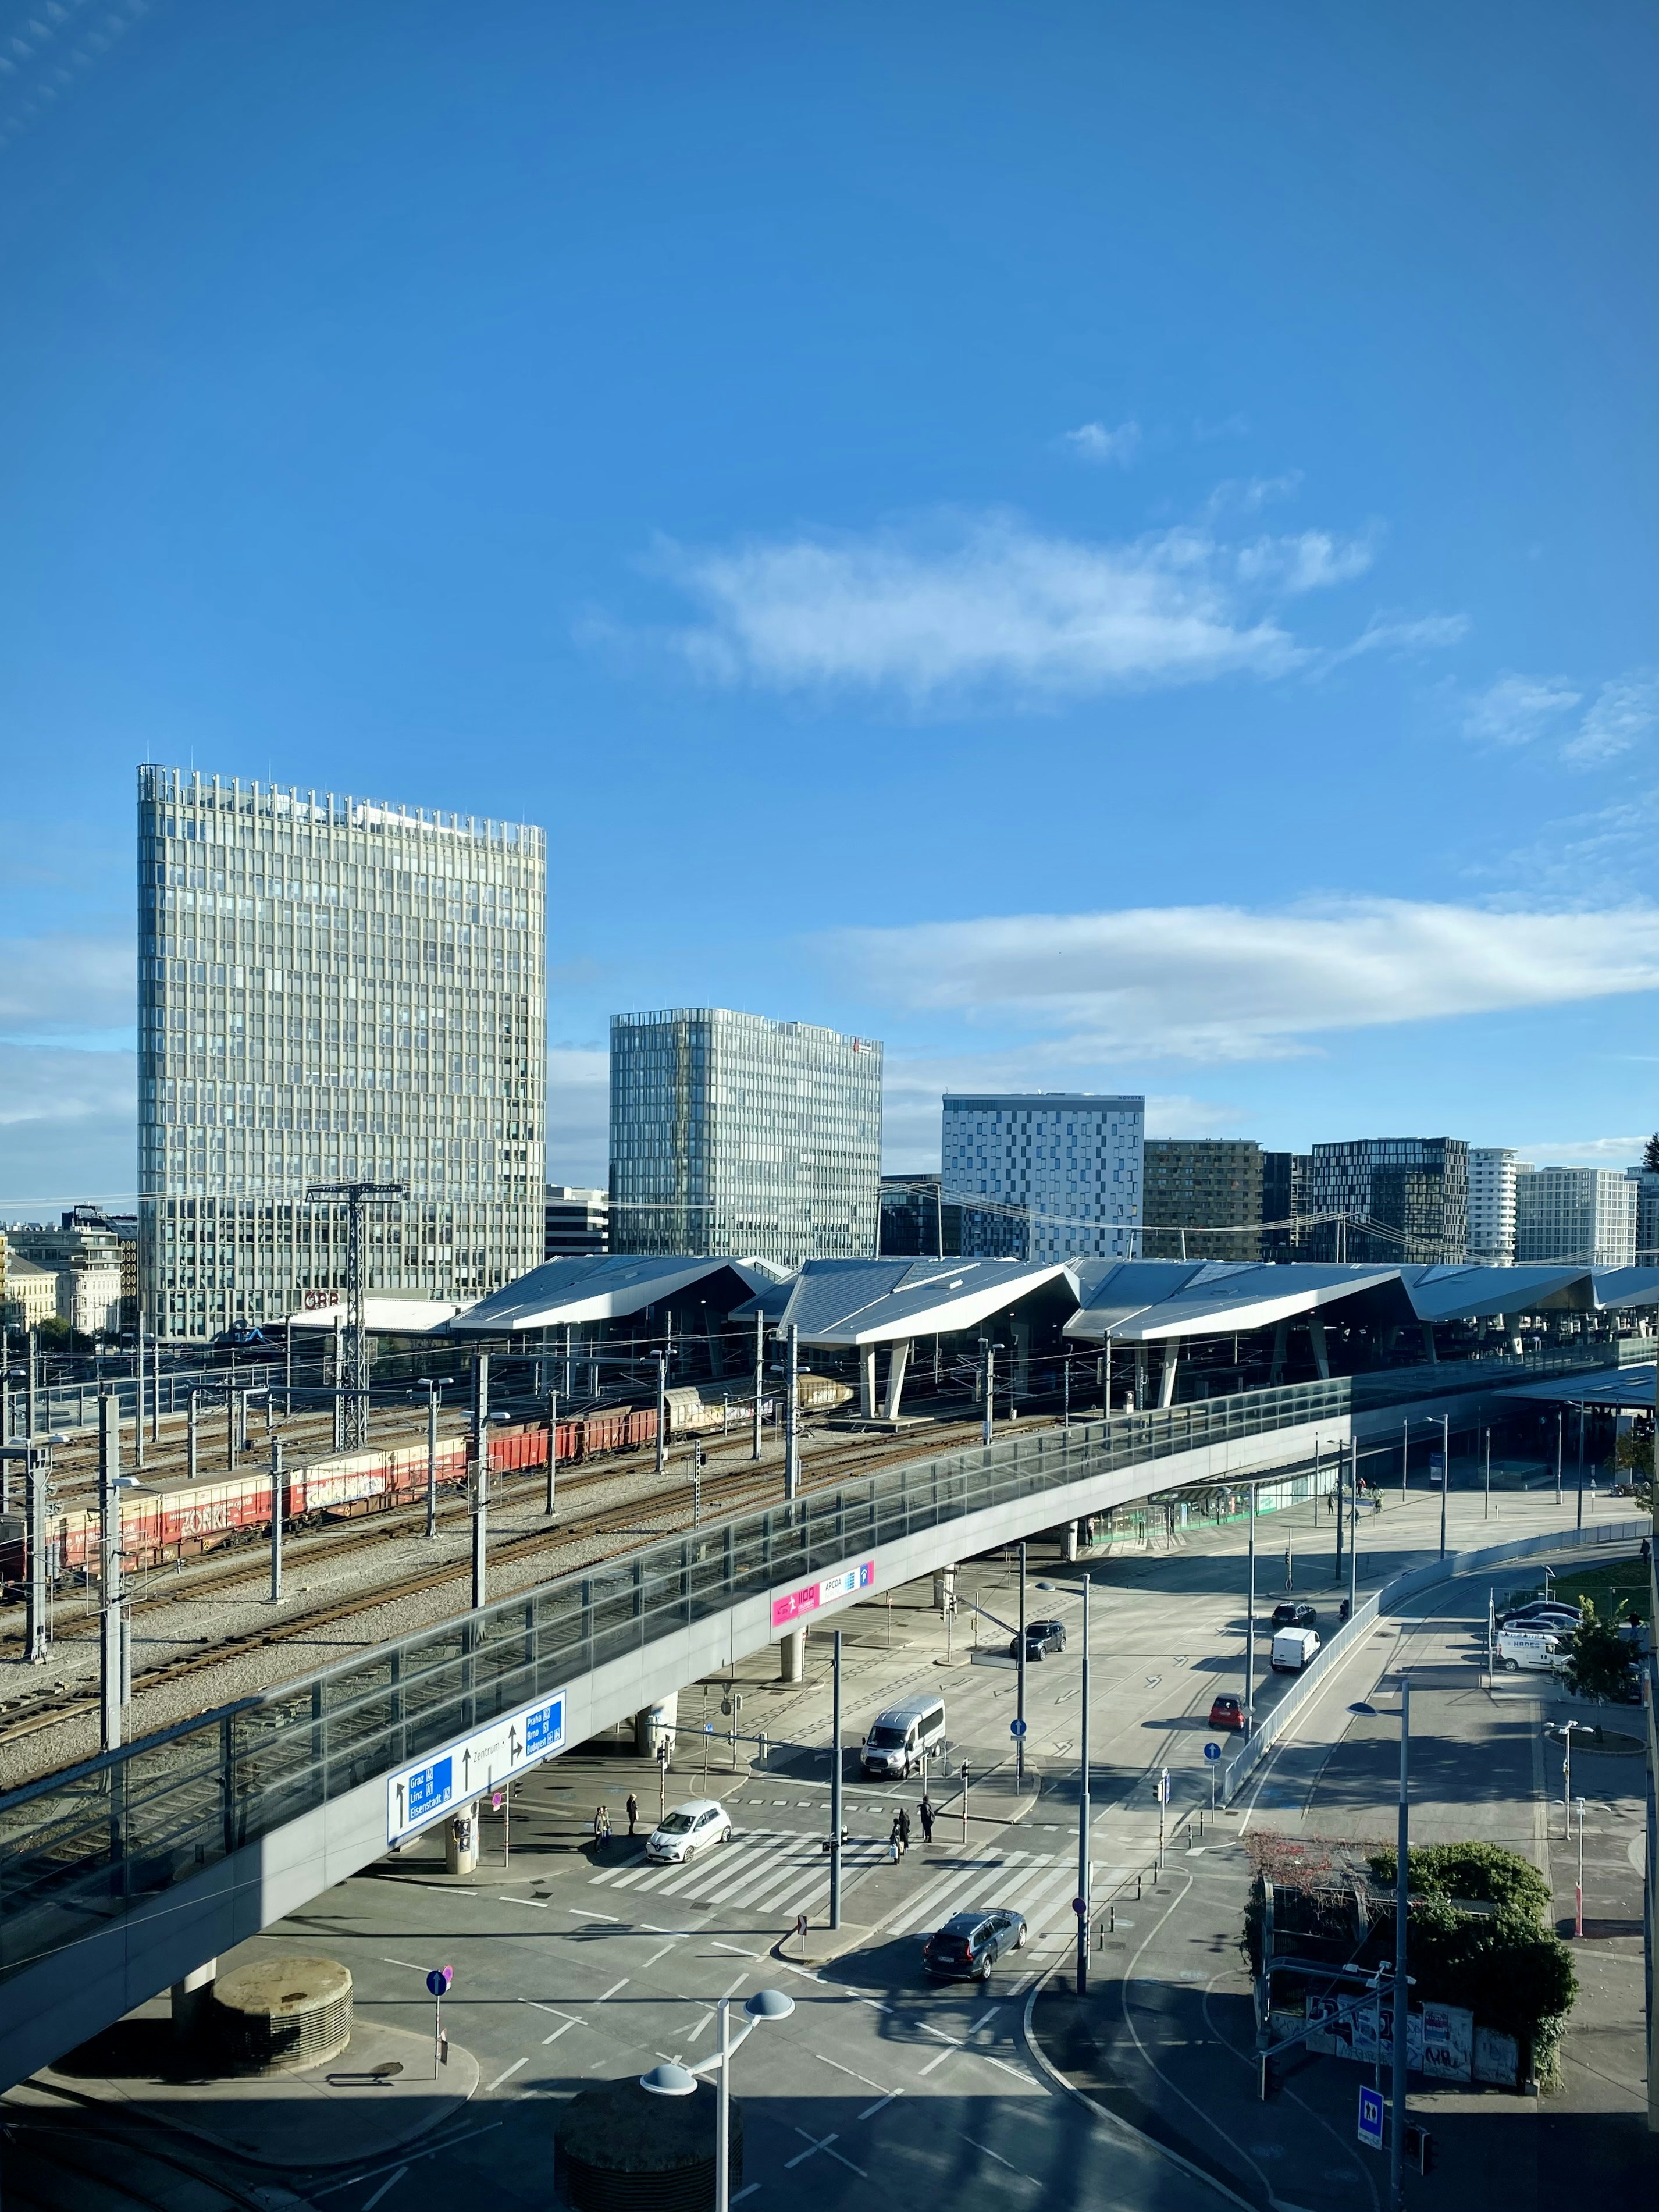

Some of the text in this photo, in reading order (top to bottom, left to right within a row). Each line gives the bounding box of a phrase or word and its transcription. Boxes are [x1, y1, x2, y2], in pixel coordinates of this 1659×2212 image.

[825, 1578, 842, 1591] APCOA
[527, 1714, 542, 1729] Praha
[527, 1729, 539, 1741] Brno
[474, 1742, 500, 1763] Zentrum
[527, 1737, 547, 1755] Budapest
[410, 1774, 425, 1789] Graz
[410, 1790, 423, 1804] Linz
[410, 1793, 442, 1819] Eisenstadt
